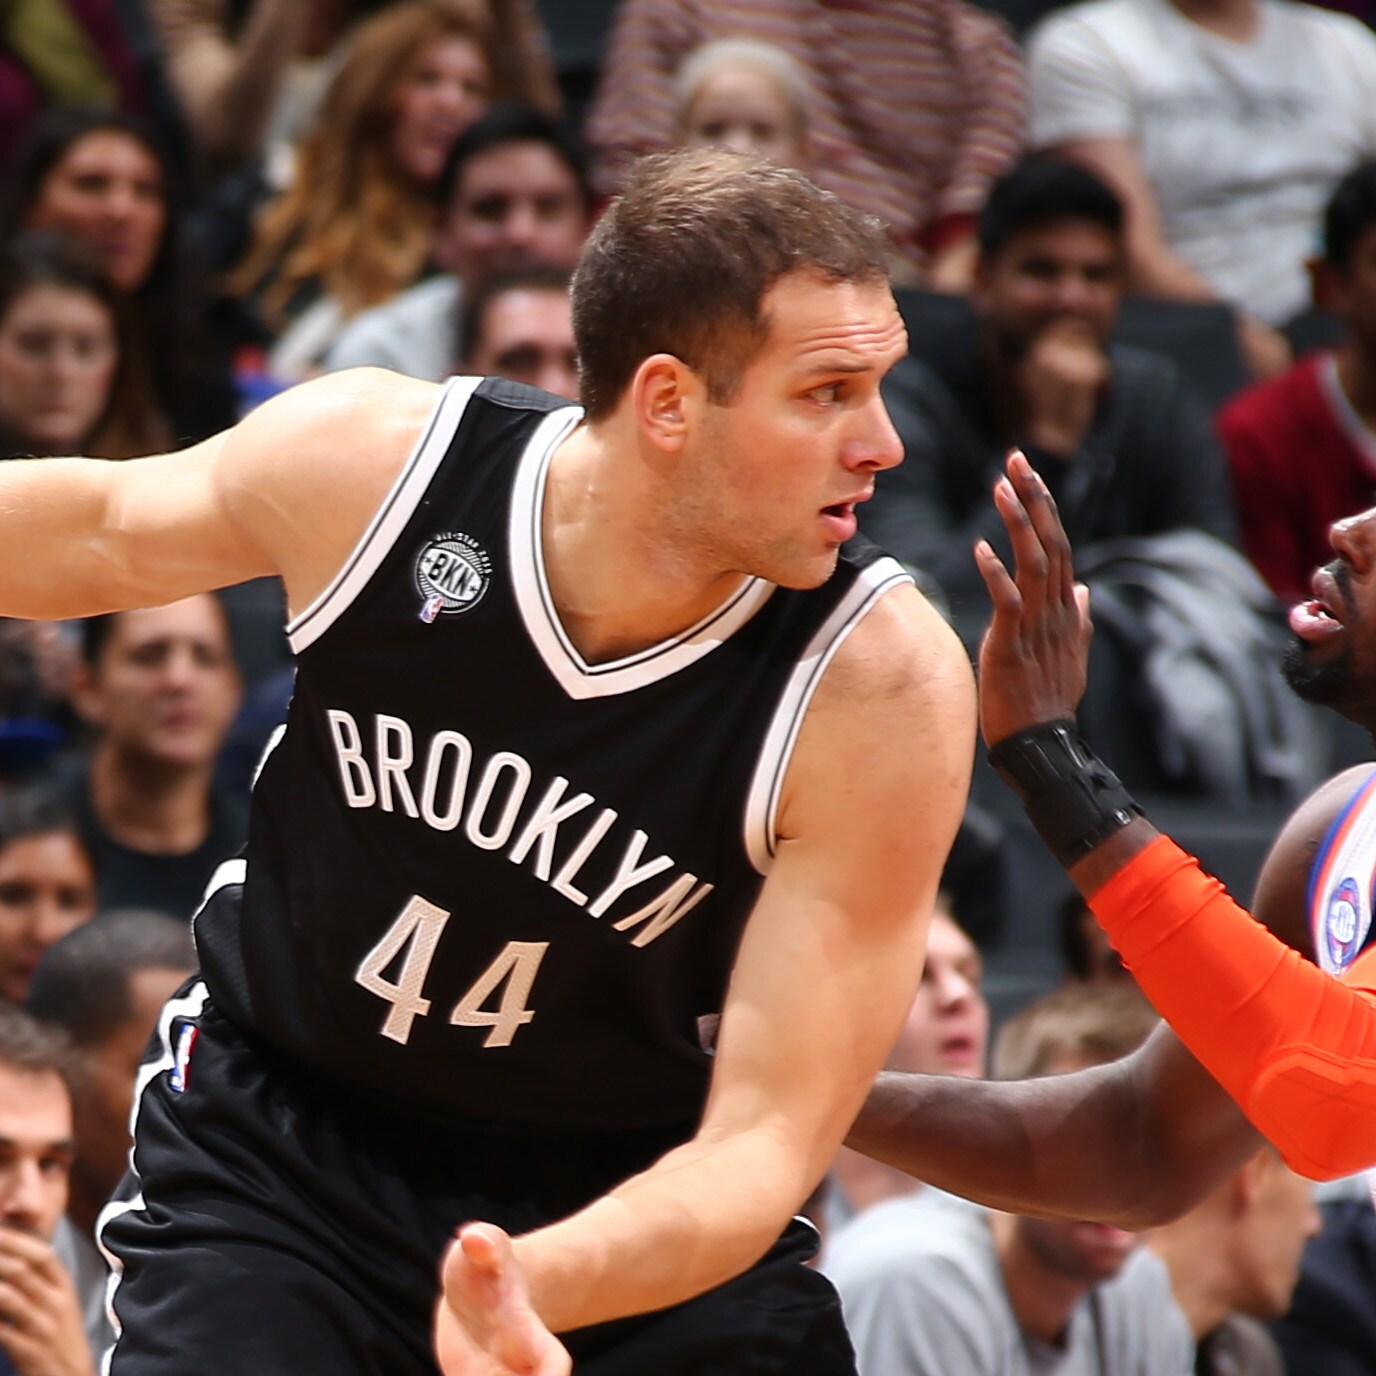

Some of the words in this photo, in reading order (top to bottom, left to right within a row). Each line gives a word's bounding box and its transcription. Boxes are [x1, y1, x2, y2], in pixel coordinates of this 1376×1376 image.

[428, 553, 476, 597] BKN
[327, 709, 714, 948] BROOKLYN
[354, 895, 551, 1048] 44
